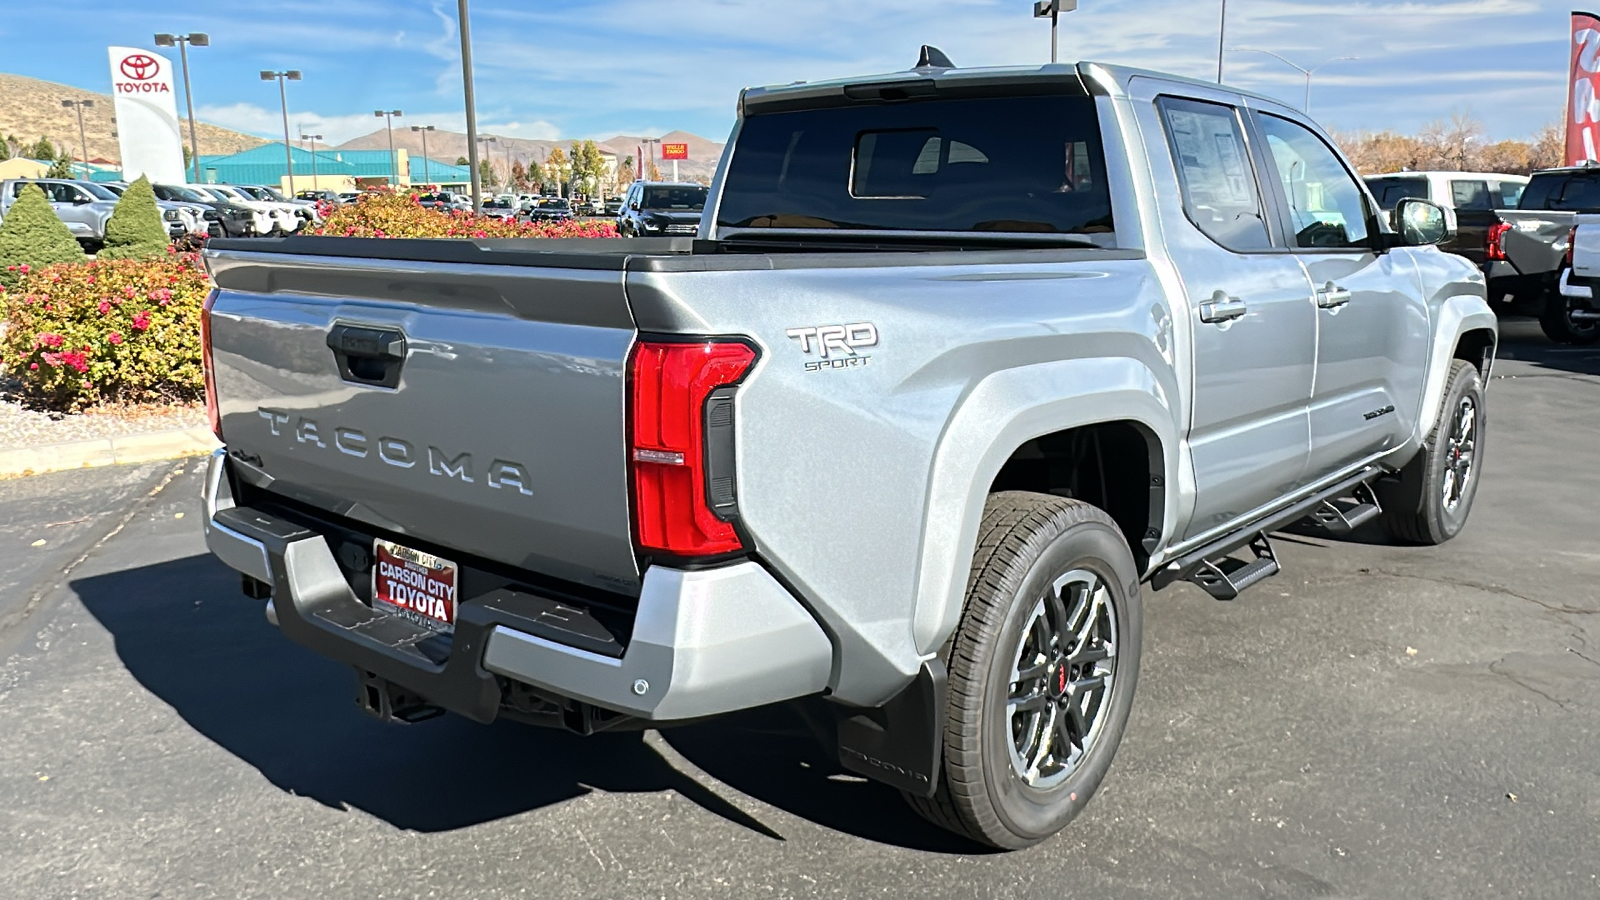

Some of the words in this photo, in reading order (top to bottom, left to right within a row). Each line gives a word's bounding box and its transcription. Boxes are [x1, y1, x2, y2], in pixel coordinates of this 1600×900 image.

[115, 82, 170, 93] TOYOTA
[786, 322, 879, 358] TRD
[804, 355, 872, 372] SPORT
[258, 406, 534, 496] TACOMA
[380, 561, 426, 590] CARSON
[427, 578, 454, 601] CITY
[386, 580, 448, 621] TOYOTA
